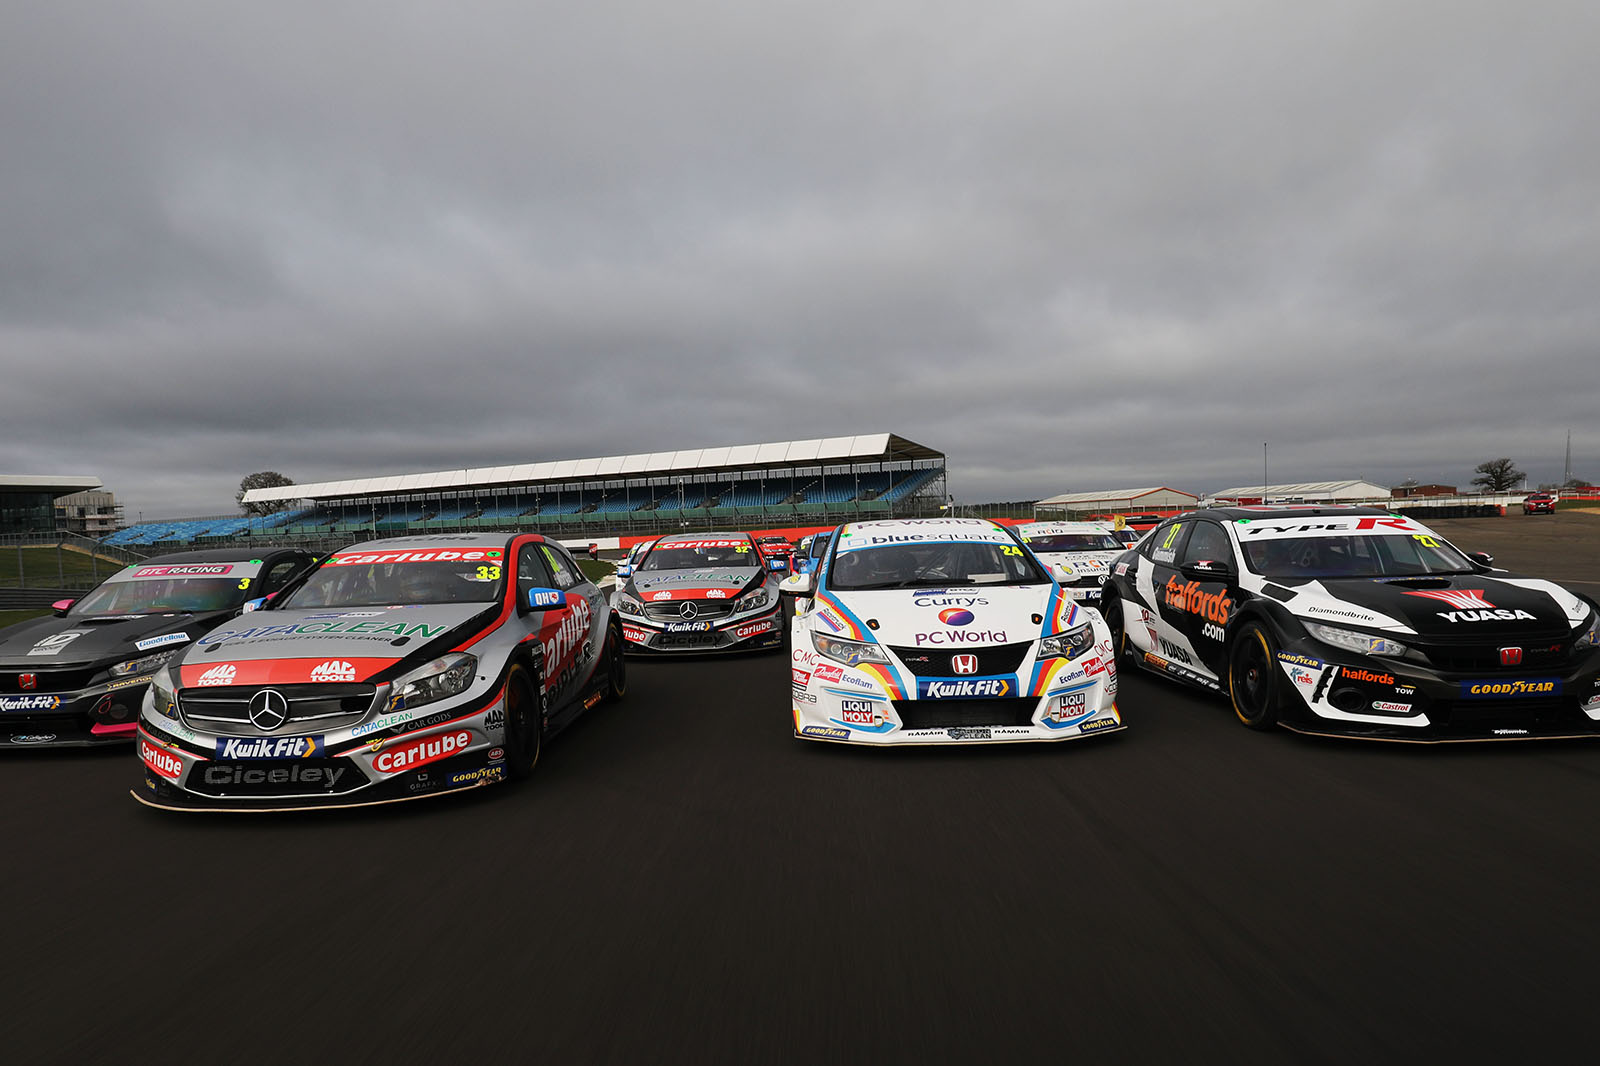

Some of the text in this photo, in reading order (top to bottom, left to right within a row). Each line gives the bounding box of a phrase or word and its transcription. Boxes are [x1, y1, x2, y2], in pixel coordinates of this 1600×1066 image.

[1247, 518, 1417, 535] TYPE R
[1412, 534, 1440, 548] 27
[1000, 545, 1024, 557] 24
[138, 566, 224, 576] BTC RACING
[475, 566, 501, 580] 33
[238, 578, 250, 590] 3
[914, 597, 989, 607] Currys
[1308, 606, 1375, 622] Diamondbrite
[1436, 609, 1537, 623] YUASA
[196, 621, 449, 646] CATACLEAN
[737, 621, 771, 637] Carlube
[915, 630, 1008, 646] PC World
[793, 649, 821, 666] CMC
[1159, 638, 1194, 666] YUASA
[310, 660, 356, 675] MAC
[1277, 652, 1319, 668] GOODYEAR
[200, 664, 237, 680] MAC
[310, 674, 355, 682] TOOLS
[1060, 669, 1085, 684] Ecoflam
[1341, 667, 1395, 685] halfords
[112, 676, 153, 689] RAVENO
[198, 678, 233, 686] TOOLS
[842, 674, 873, 689] Ecoflam
[1470, 680, 1555, 695] GOODYEAR
[1395, 687, 1414, 695] TOW
[843, 701, 871, 712] LIQUI
[1061, 694, 1084, 707] LIQUI
[1381, 702, 1410, 711] Castrol
[844, 712, 872, 722] MOLY
[1061, 704, 1085, 718] MOLY
[351, 712, 413, 737] CATACLEAN
[407, 712, 452, 731] CAR GODS
[1082, 719, 1115, 731] GOODYEAR
[806, 727, 847, 737] GOODYEAR
[377, 732, 468, 770] Carlube
[142, 742, 183, 776] Carlube
[204, 764, 346, 788] Ciceley
[452, 767, 502, 783] GOODYEAR
